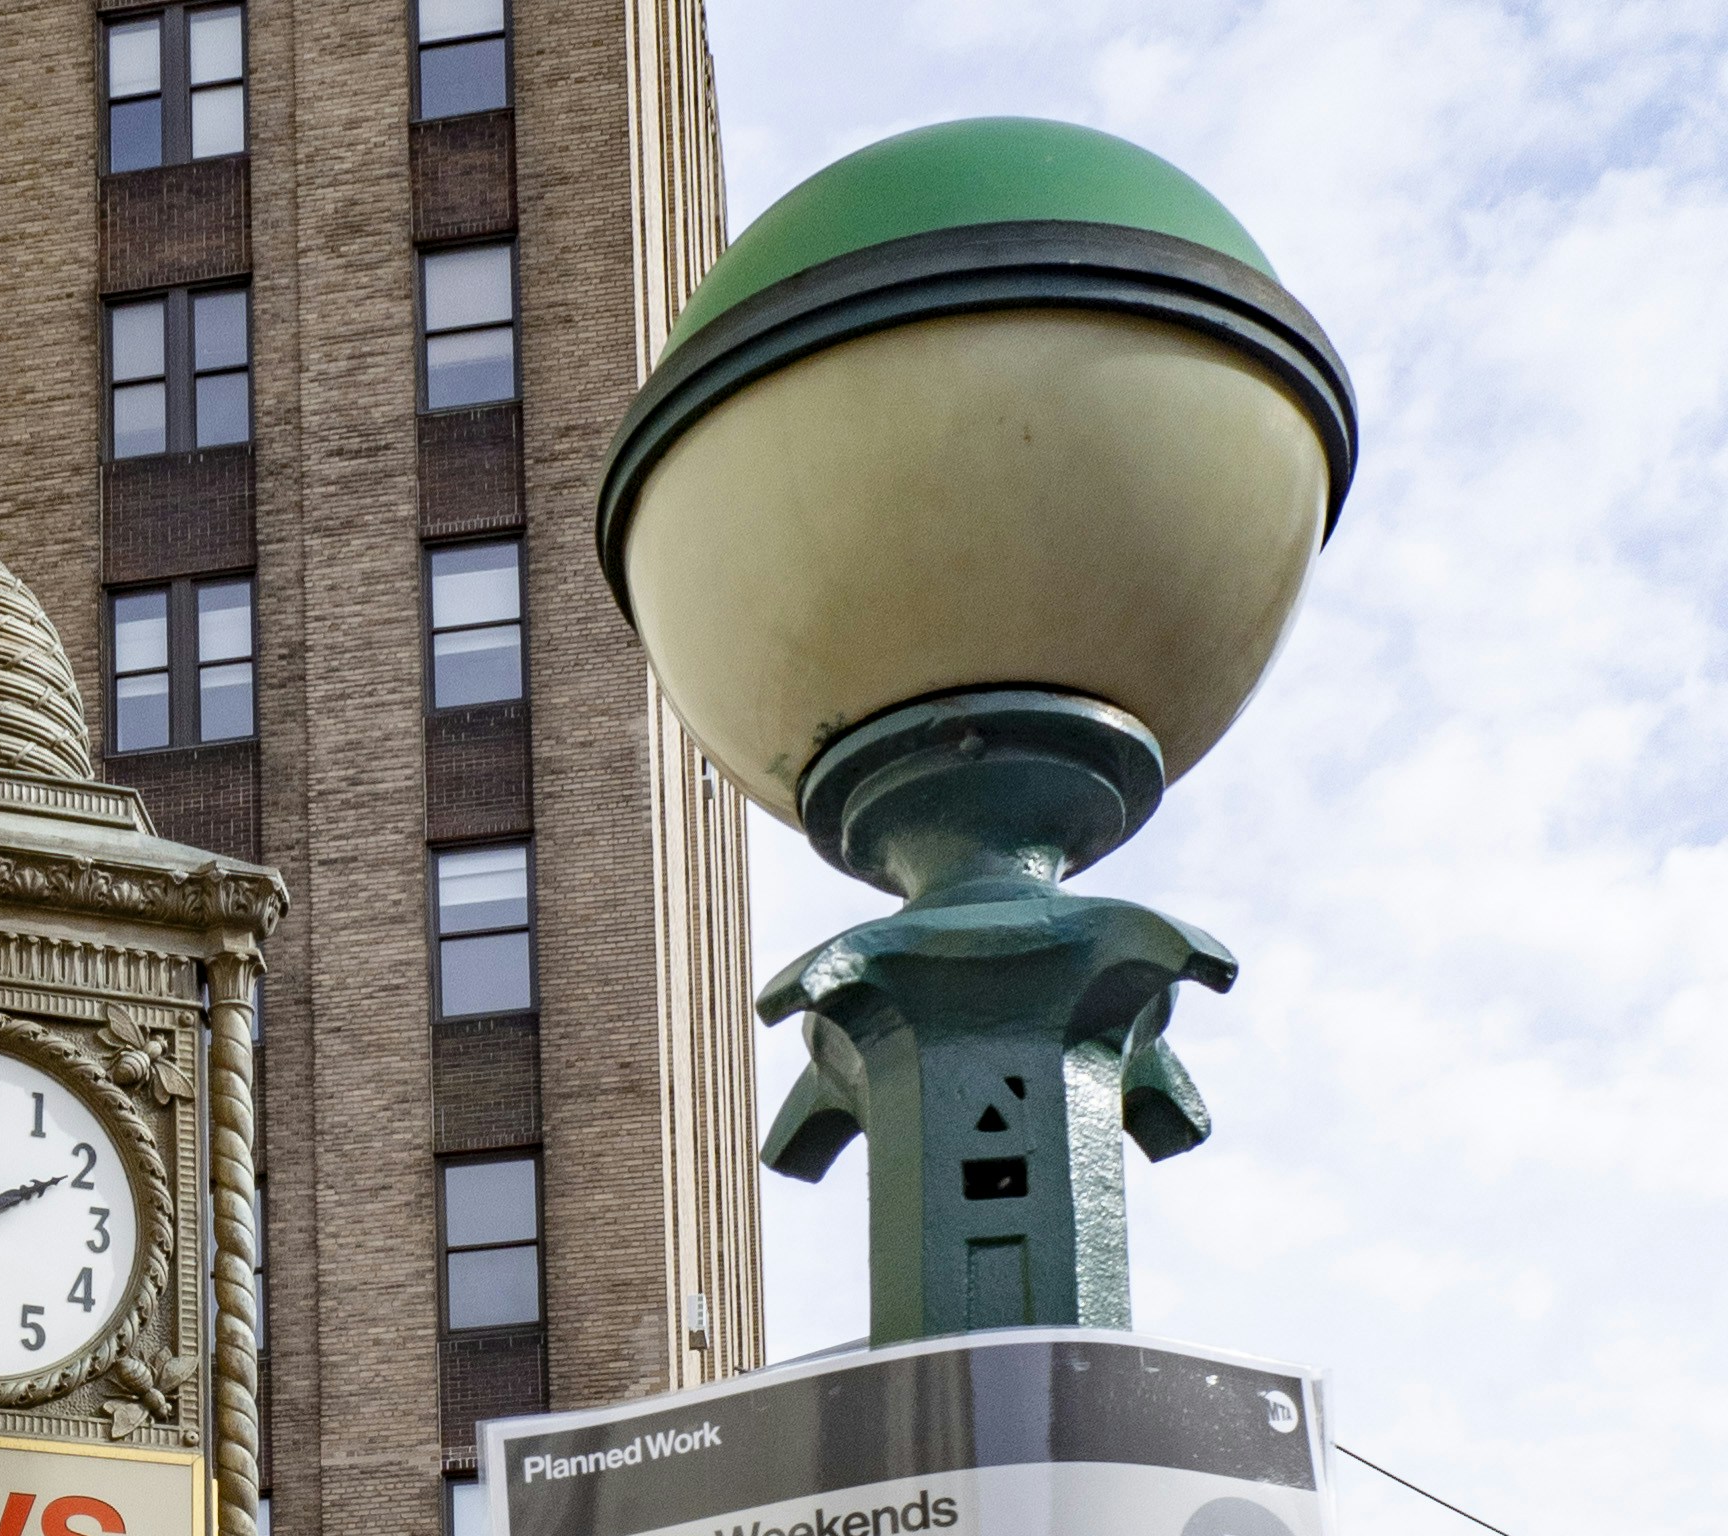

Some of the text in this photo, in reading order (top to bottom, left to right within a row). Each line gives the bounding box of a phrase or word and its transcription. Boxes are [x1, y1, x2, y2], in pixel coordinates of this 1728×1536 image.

[31, 1093, 46, 1138] 1
[71, 1143, 96, 1190] 2
[88, 1208, 109, 1253] 3
[67, 1267, 95, 1312] 4
[20, 1305, 45, 1350] 5
[524, 1421, 722, 1483] Planned Work
